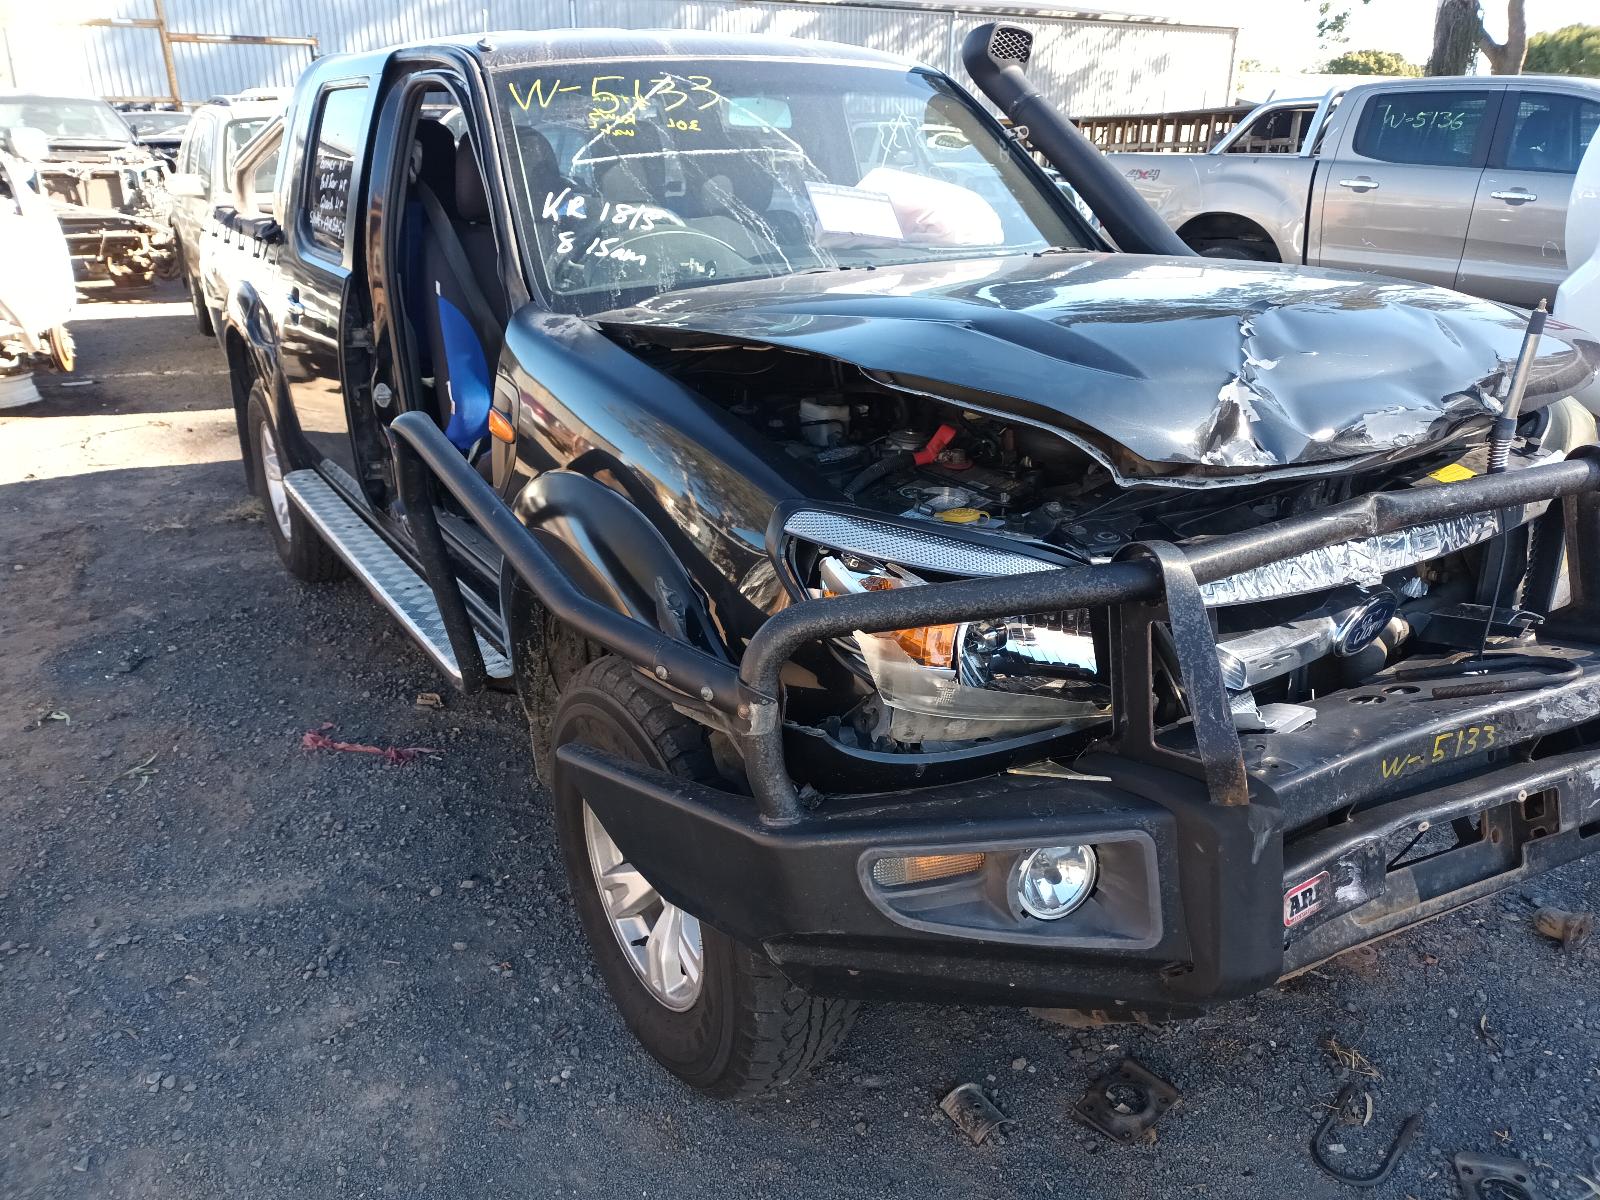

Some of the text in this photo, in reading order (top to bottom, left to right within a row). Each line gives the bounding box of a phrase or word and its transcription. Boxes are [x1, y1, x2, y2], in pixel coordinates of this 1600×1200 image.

[1383, 104, 1465, 131] W-5136
[542, 187, 587, 221] KR
[1382, 725, 1496, 779] W-5133
